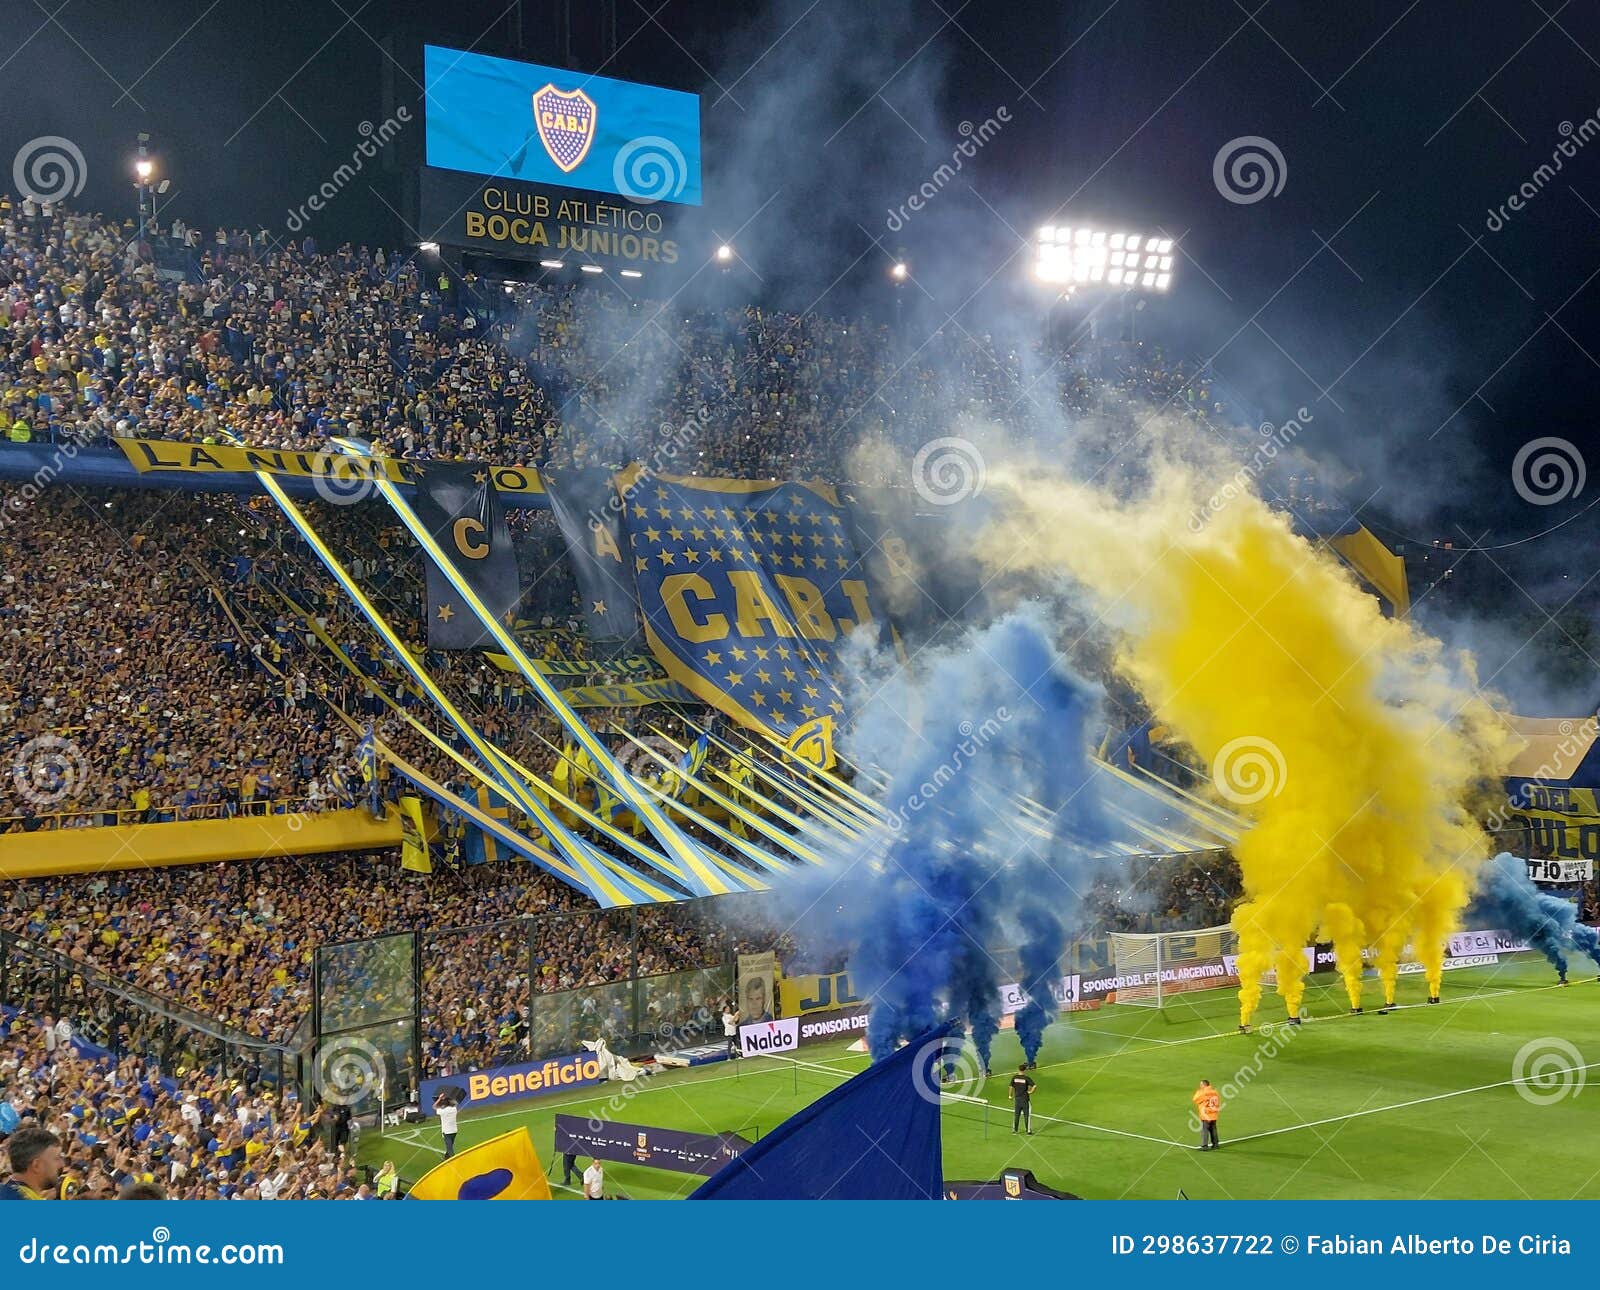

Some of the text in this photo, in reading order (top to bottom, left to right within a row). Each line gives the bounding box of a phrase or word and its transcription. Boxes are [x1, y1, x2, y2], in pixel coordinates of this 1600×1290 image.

[542, 111, 588, 134] CABJ
[483, 188, 663, 233] CLUB ATLÉTICO
[466, 211, 679, 265] BOCA JUNIORS
[138, 442, 224, 469] LA
[453, 517, 490, 560] C
[659, 570, 875, 644] CABJ
[1083, 976, 1125, 994] SPONSOR
[1127, 973, 1144, 988] DEL
[1178, 964, 1224, 980] ARGENTINO
[746, 1029, 793, 1051] Naldo
[801, 1019, 851, 1038] SPONSOR
[469, 1058, 600, 1100] Beneficio
